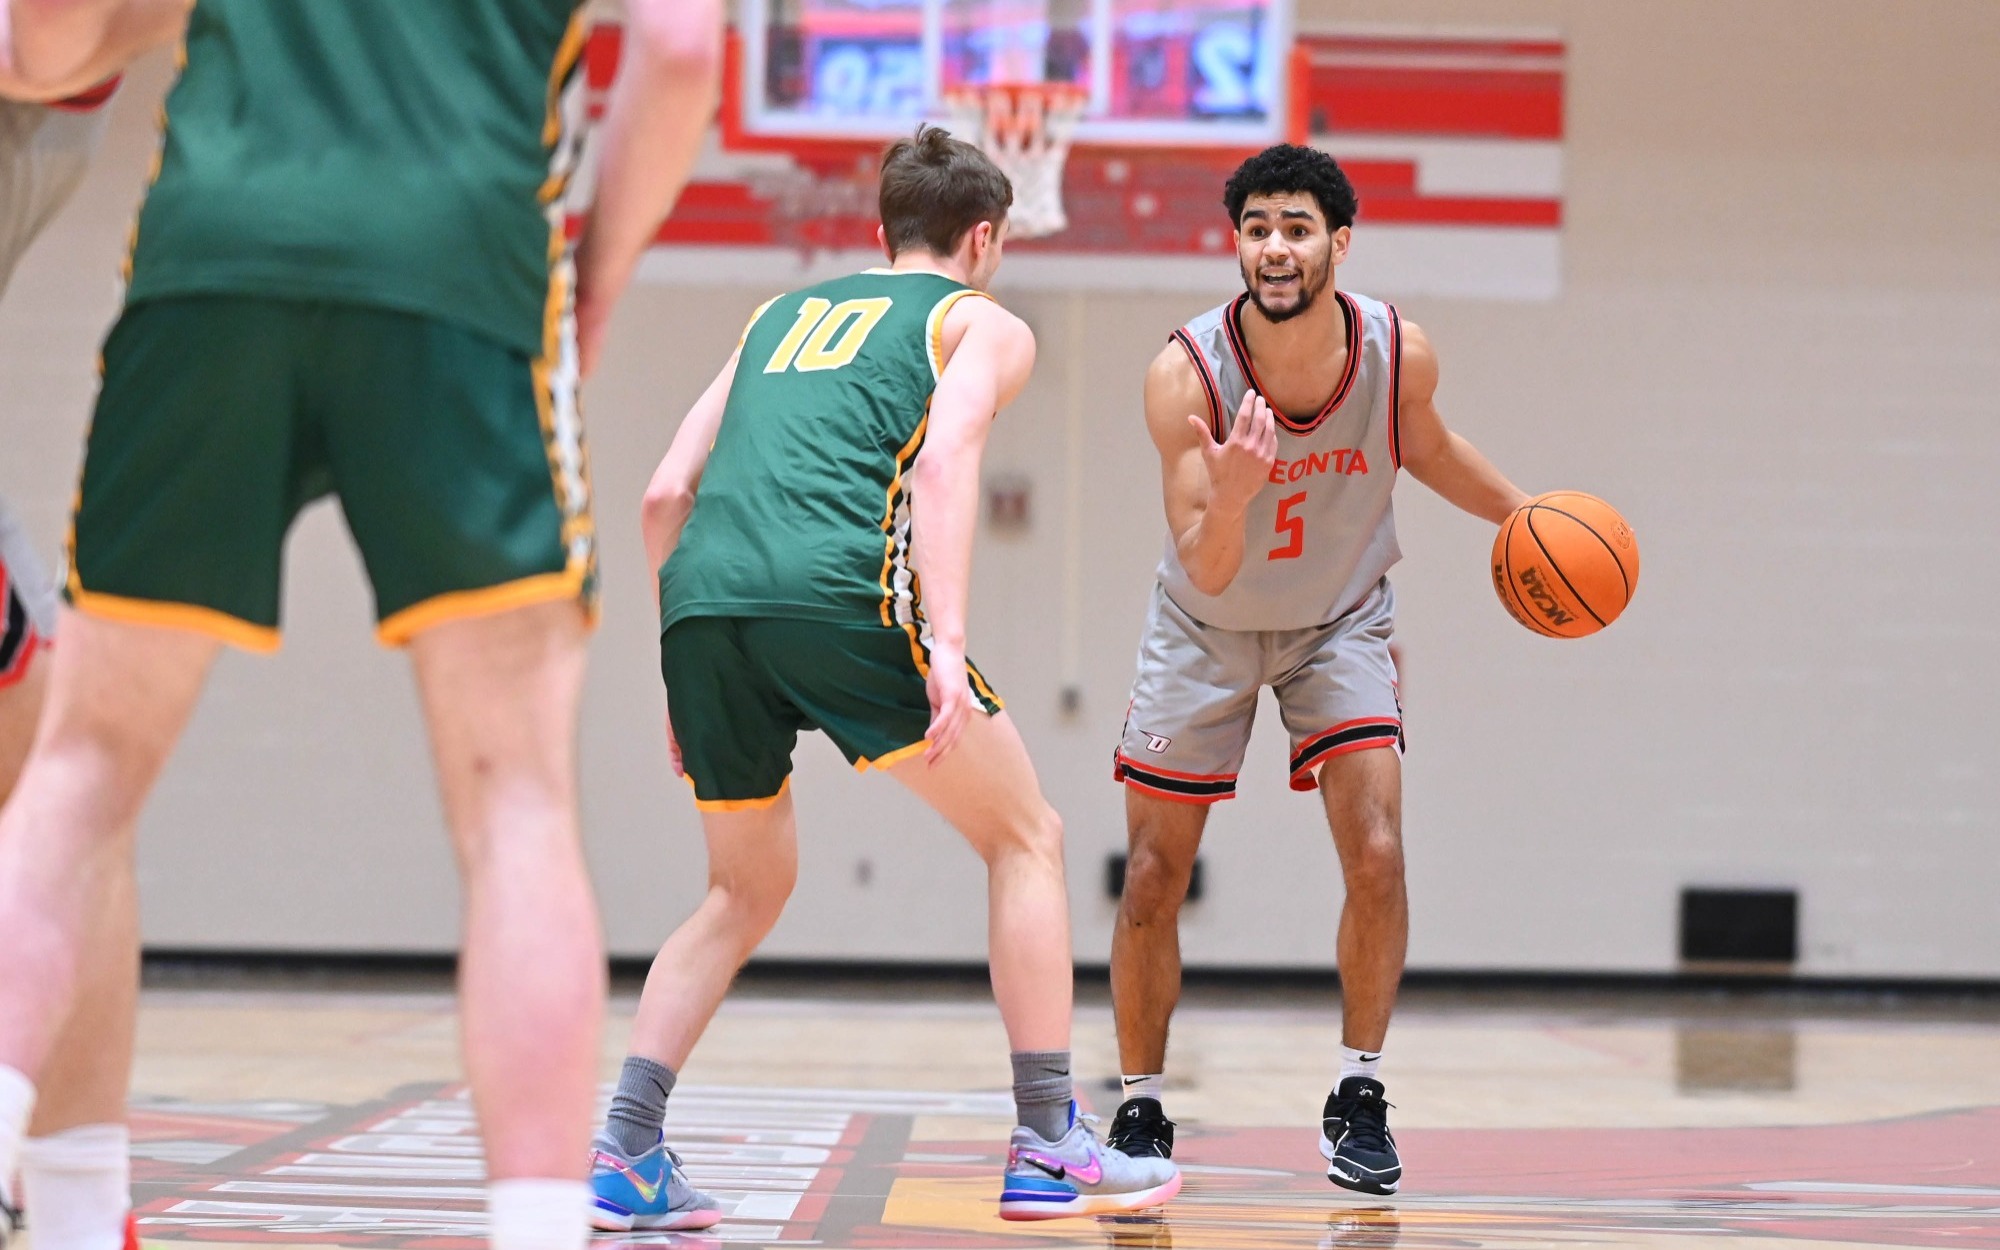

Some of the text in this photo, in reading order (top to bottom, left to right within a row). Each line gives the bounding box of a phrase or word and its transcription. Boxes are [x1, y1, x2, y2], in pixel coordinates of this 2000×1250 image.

[763, 297, 893, 374] 10
[1268, 448, 1369, 485] EONTA
[1267, 491, 1308, 561] 5
[1518, 566, 1575, 627] NCAA
